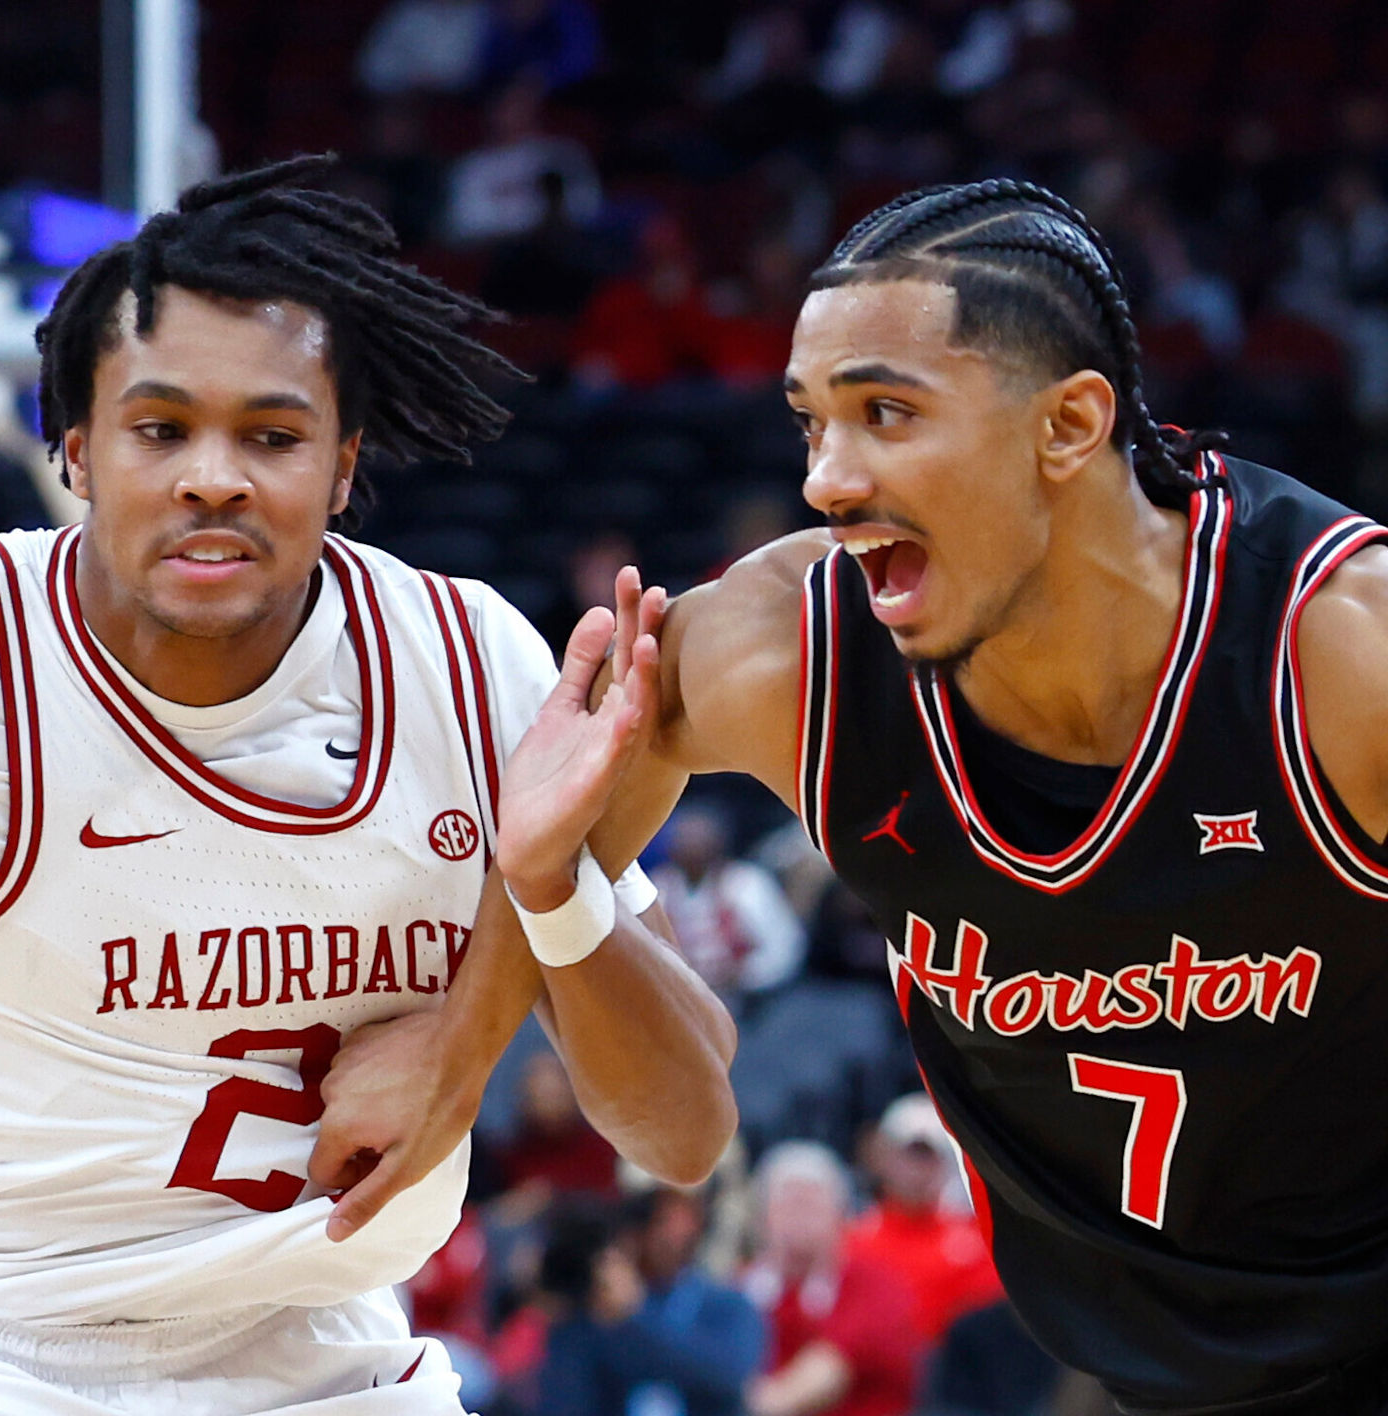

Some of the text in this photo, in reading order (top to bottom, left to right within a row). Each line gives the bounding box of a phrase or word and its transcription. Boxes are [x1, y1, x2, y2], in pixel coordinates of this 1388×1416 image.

[432, 813, 475, 857] SEC
[96, 919, 474, 1015] RAZORBACK
[898, 910, 1322, 1037] Houston
[166, 1021, 343, 1213] 2
[1067, 1052, 1188, 1230] 7
